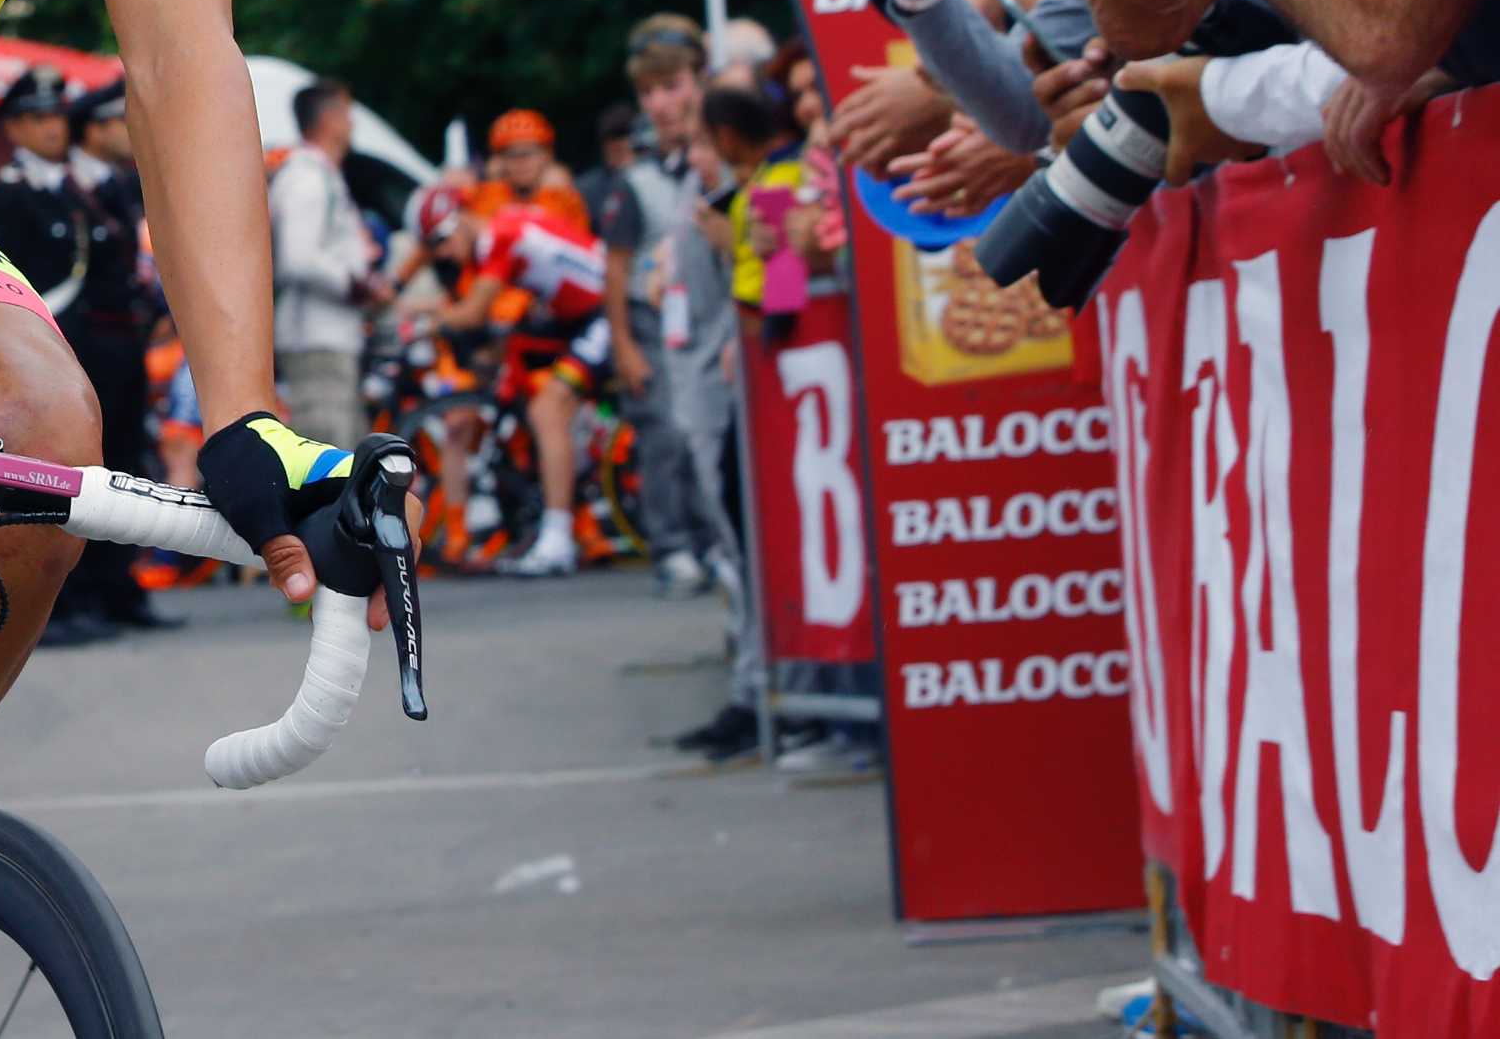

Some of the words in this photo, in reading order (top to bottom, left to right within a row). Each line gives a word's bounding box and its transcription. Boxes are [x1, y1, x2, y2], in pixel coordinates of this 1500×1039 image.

[883, 406, 1118, 465] BALOCC
[3, 470, 72, 491] www.SRM.de
[890, 487, 1121, 546] BALOCC
[396, 554, 419, 671] DURA-ACE
[896, 569, 1127, 627] BALOCC
[1182, 200, 1500, 981] BALO
[902, 650, 1131, 709] BALOCC
